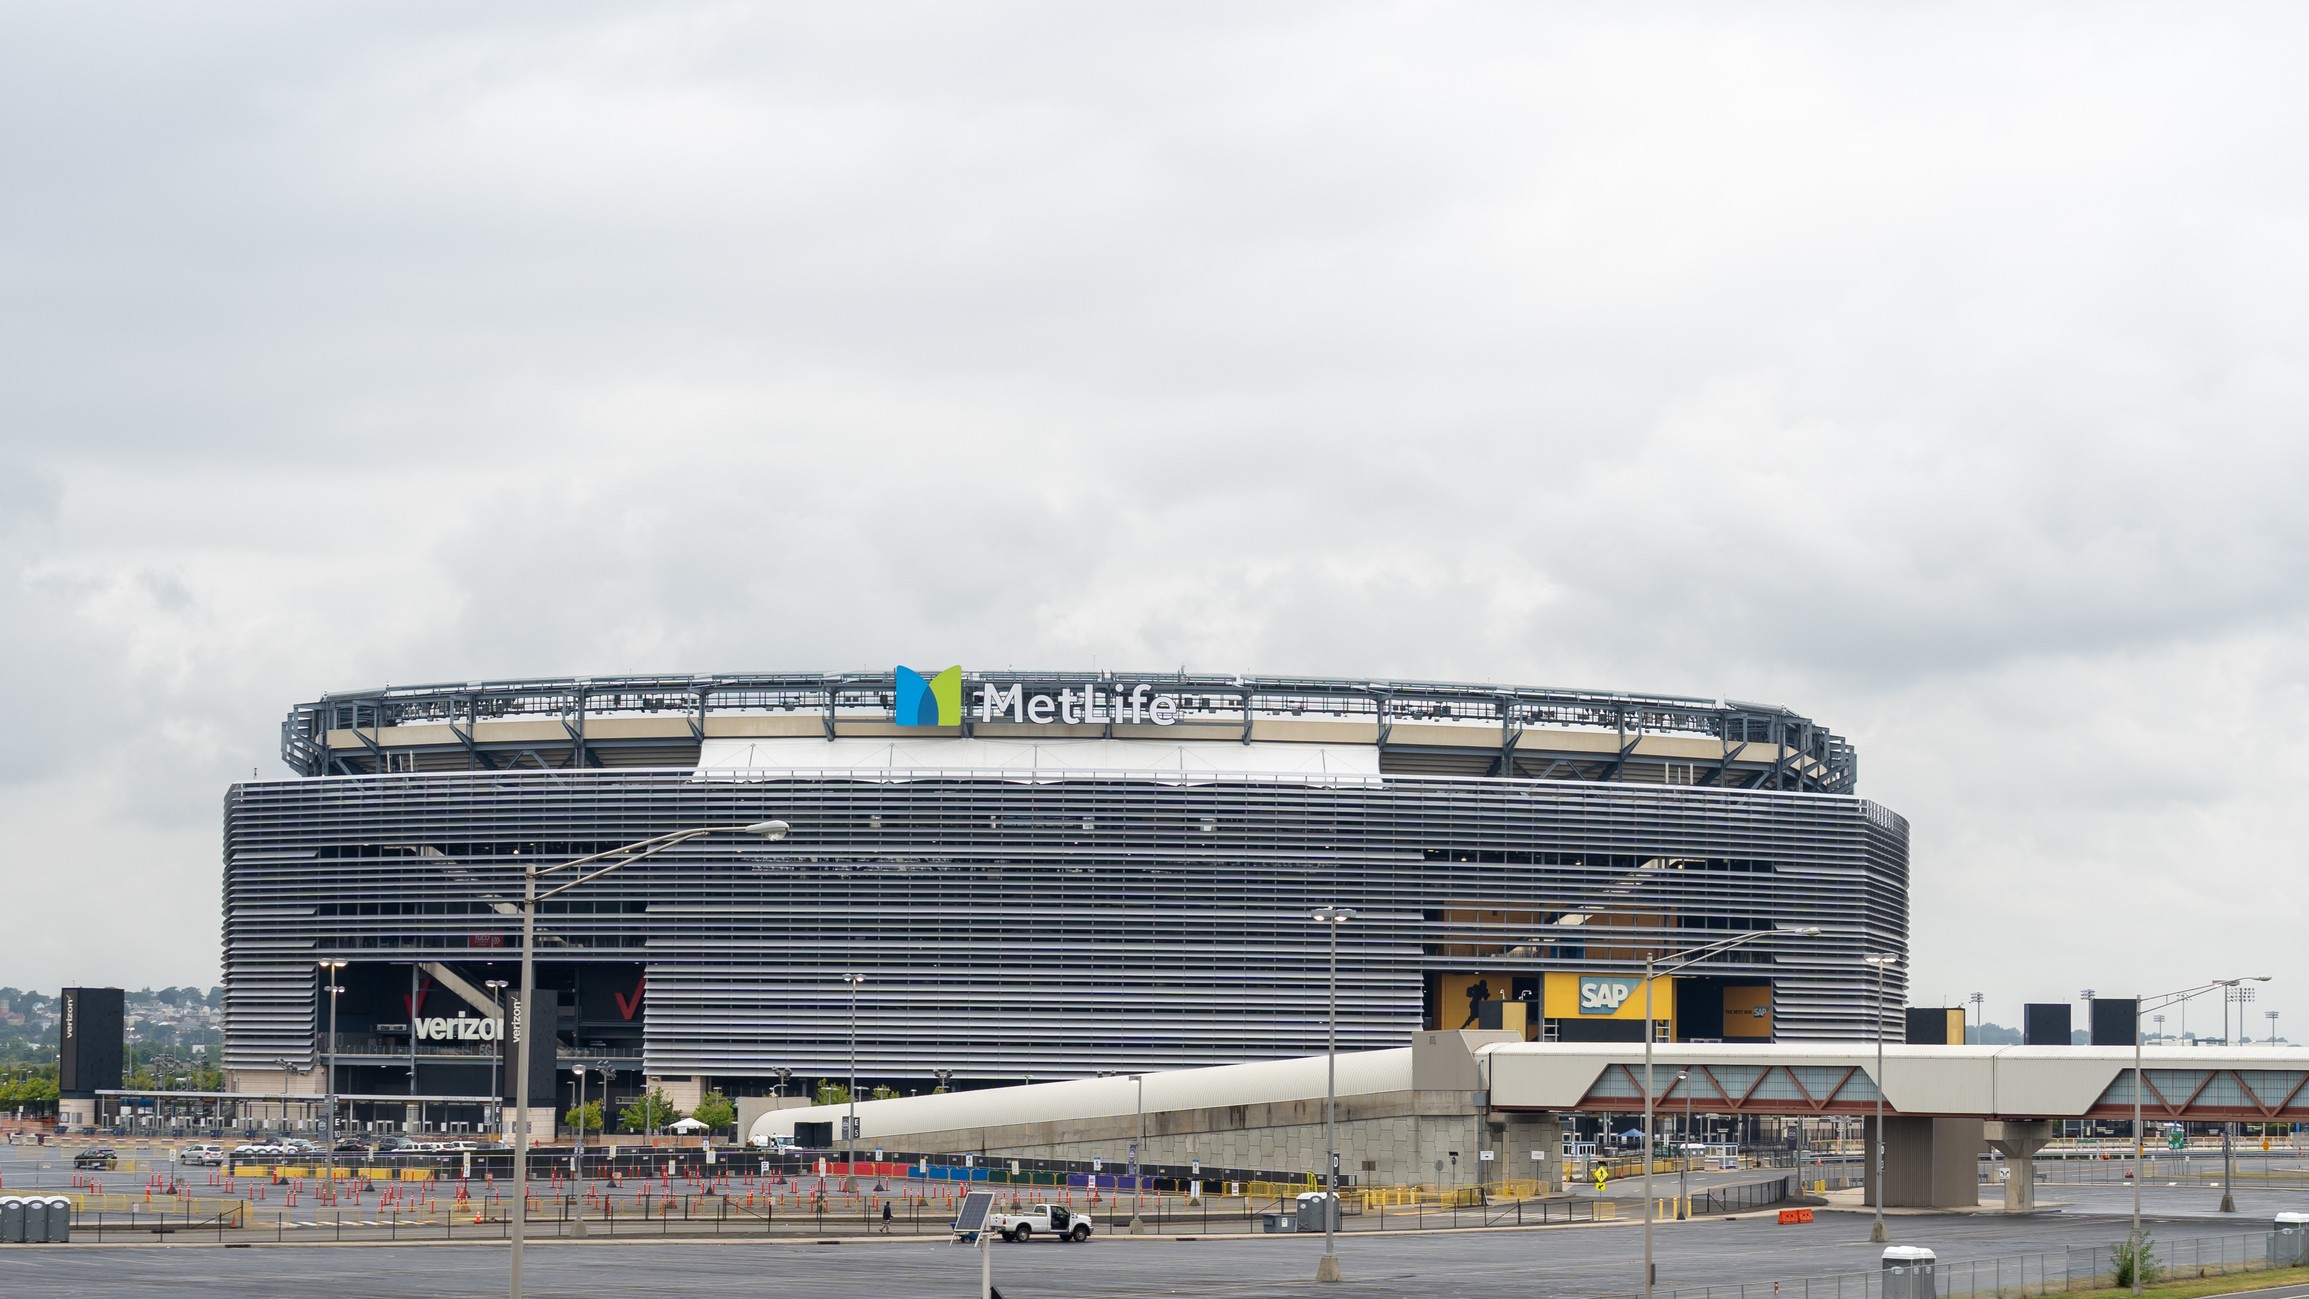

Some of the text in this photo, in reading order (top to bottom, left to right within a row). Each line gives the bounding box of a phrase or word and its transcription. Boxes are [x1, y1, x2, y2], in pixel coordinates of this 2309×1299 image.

[982, 683, 1177, 726] MetLife
[1581, 983, 1628, 1008] SAP
[511, 1000, 521, 1043] verizon
[1754, 1007, 1767, 1017] SAP
[334, 1118, 340, 1126] E
